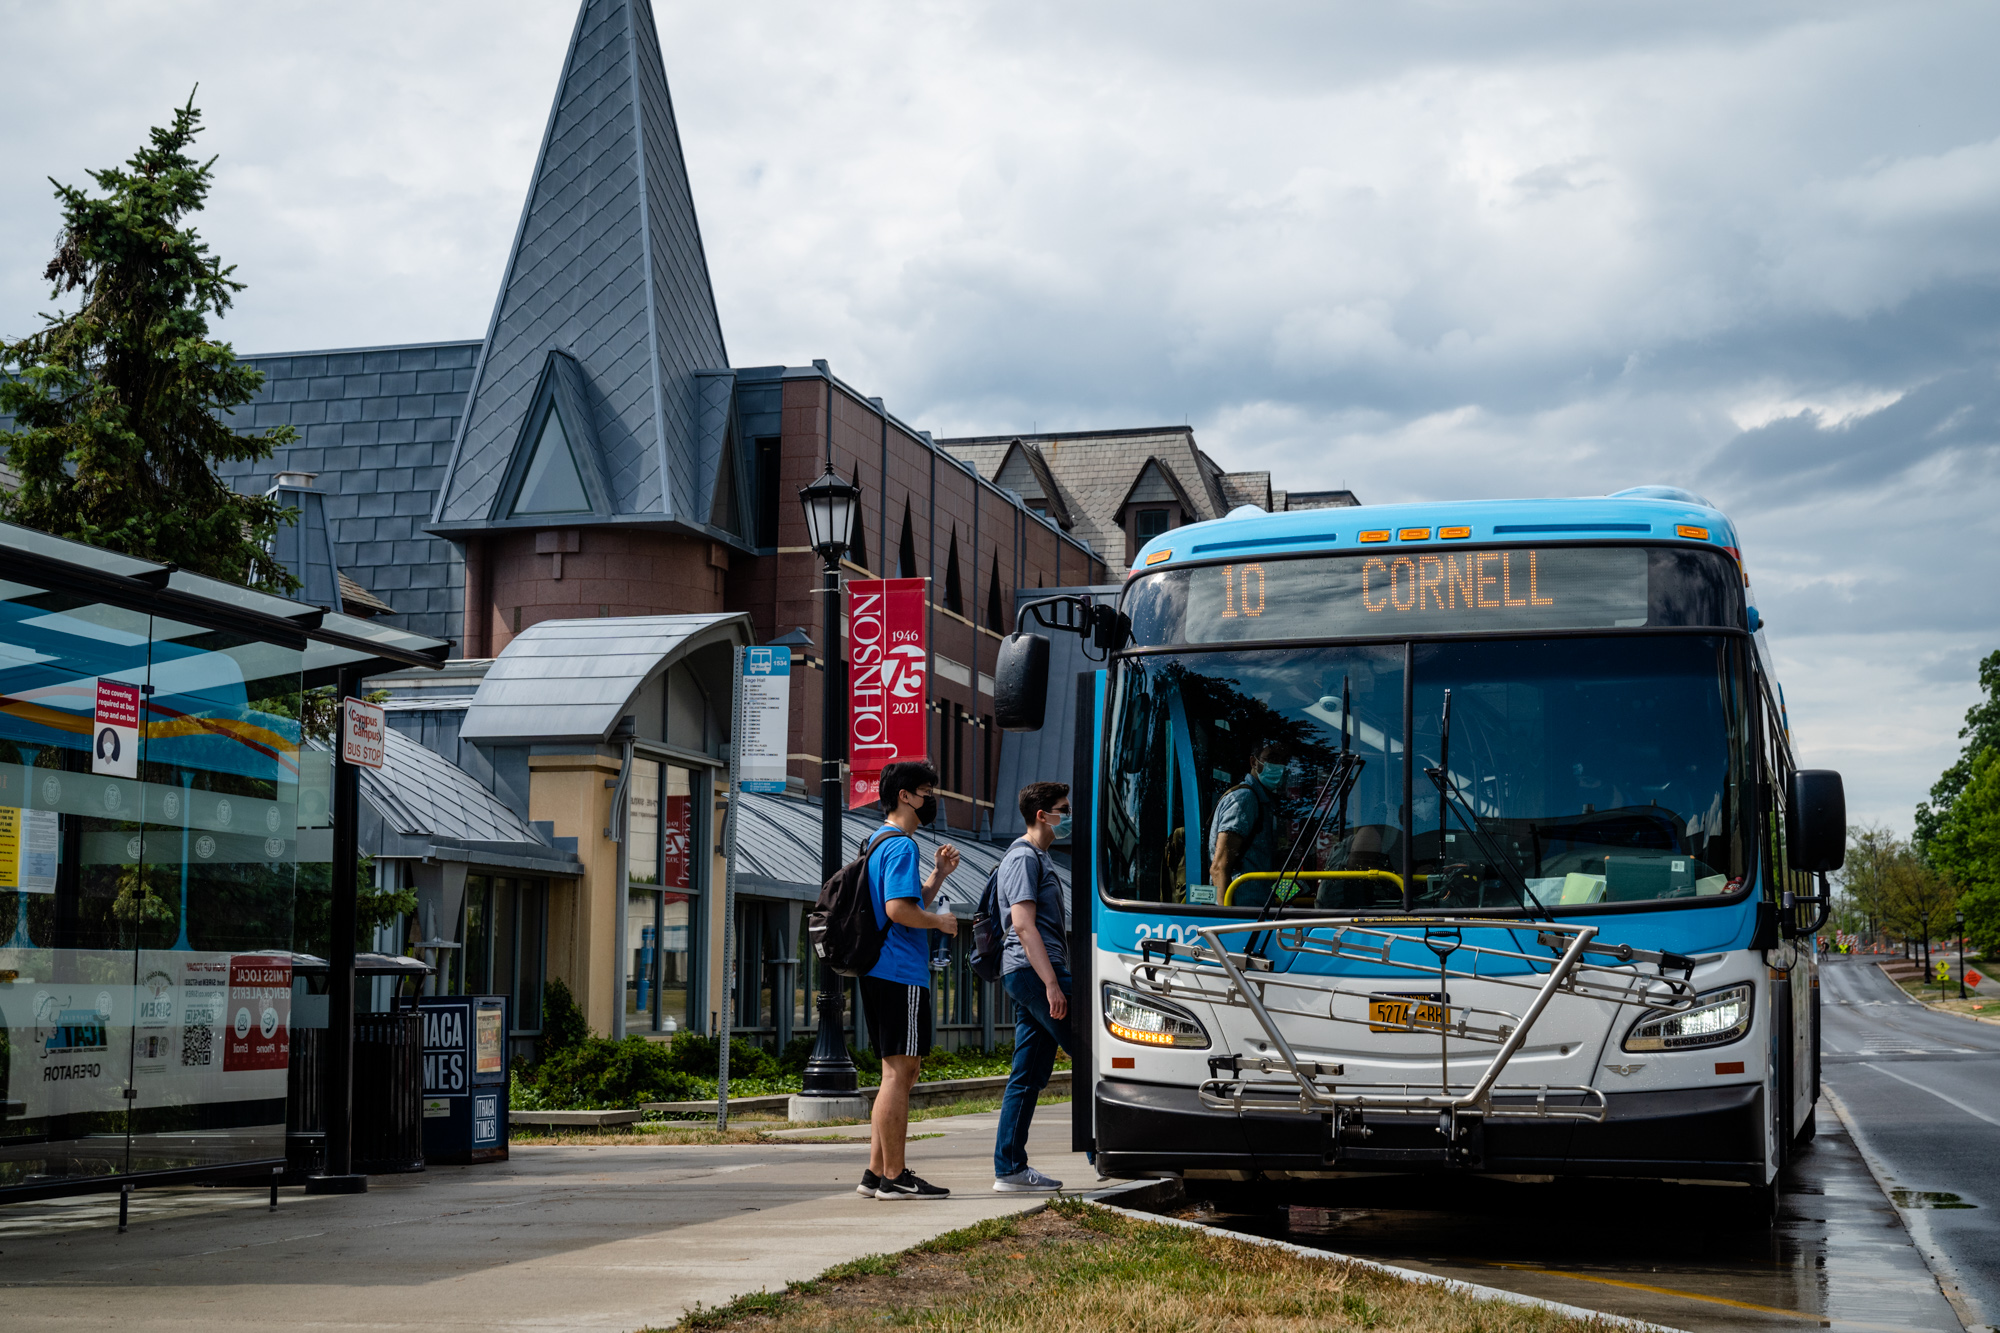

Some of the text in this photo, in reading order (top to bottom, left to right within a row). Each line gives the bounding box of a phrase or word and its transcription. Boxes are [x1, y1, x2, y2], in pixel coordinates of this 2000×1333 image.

[1222, 550, 1554, 618] 10 CORNELL
[892, 630, 919, 642] 1946
[853, 593, 898, 759] JOHNSON
[881, 644, 926, 698] 75
[99, 686, 132, 701] Face covering
[98, 699, 119, 708] required
[126, 703, 135, 711] bus
[892, 702, 919, 715] 2021
[98, 710, 109, 719] stop
[127, 714, 136, 722] bus
[351, 709, 378, 728] Campus
[353, 724, 379, 742] Campus
[347, 742, 381, 761] BUS STOP
[1134, 923, 1203, 950] 2102
[1378, 1004, 1417, 1023] 5274
[423, 1054, 463, 1090] MES
[476, 1099, 495, 1118] ITHACA
[476, 1119, 495, 1139] TIMES
